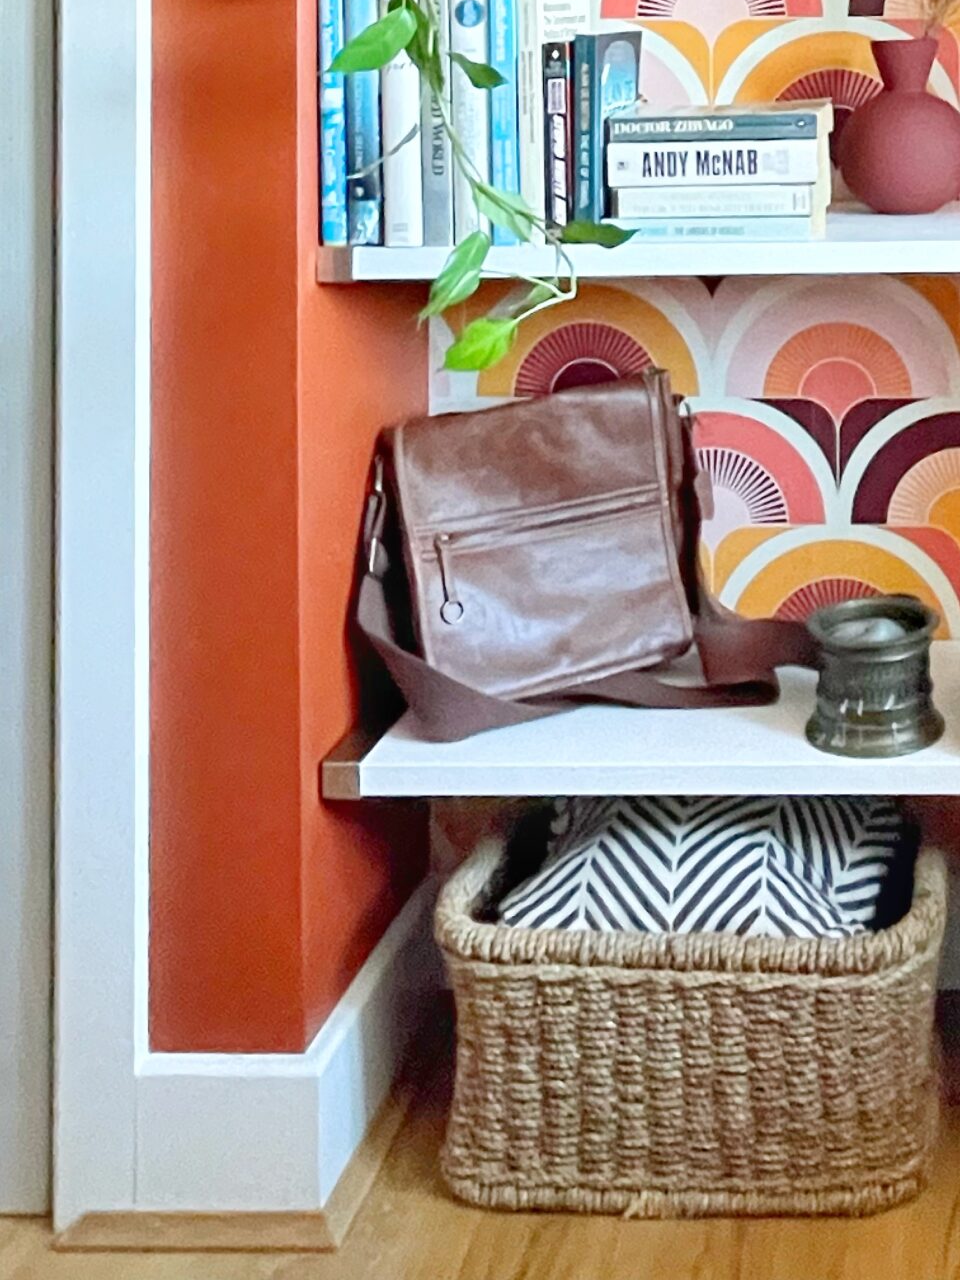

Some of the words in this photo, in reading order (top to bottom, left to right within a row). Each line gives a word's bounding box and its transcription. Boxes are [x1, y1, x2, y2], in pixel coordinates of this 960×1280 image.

[613, 120, 671, 135] DOCTOR
[642, 151, 688, 178] ANDY
[696, 149, 759, 177] McNAB
